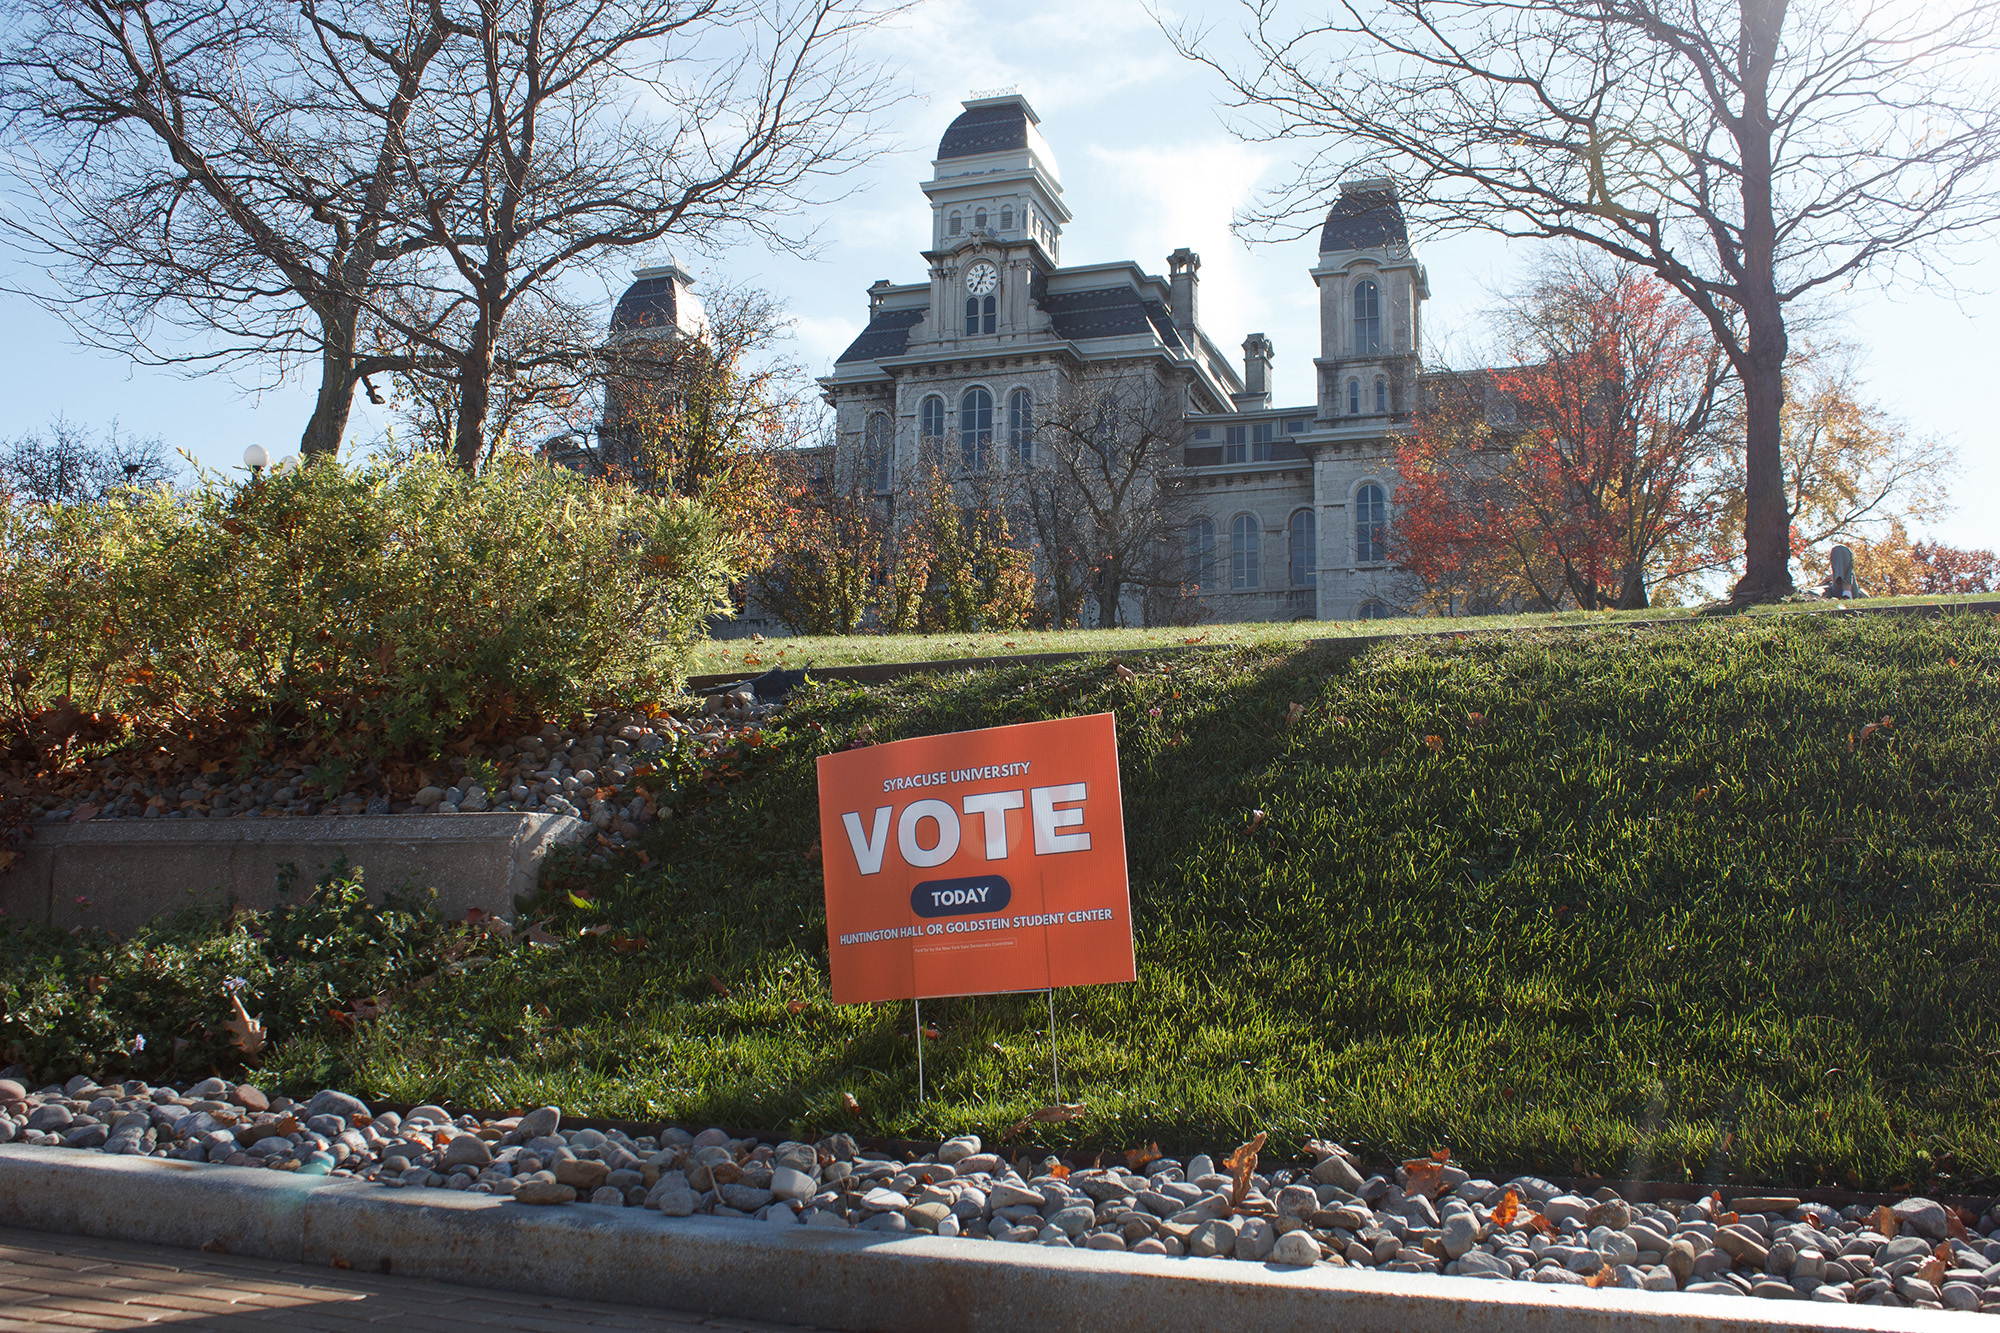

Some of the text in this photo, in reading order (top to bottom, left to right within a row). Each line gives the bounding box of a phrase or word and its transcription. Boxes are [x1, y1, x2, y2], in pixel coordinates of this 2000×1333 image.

[882, 761, 1032, 793] SYRACUSE UNIVERSITY
[841, 782, 1092, 876] VOTE
[931, 887, 990, 907] TODAY
[839, 908, 1113, 946] HUNTINGTON HALL OR GOLDSTEIN STUDENT CENTER
